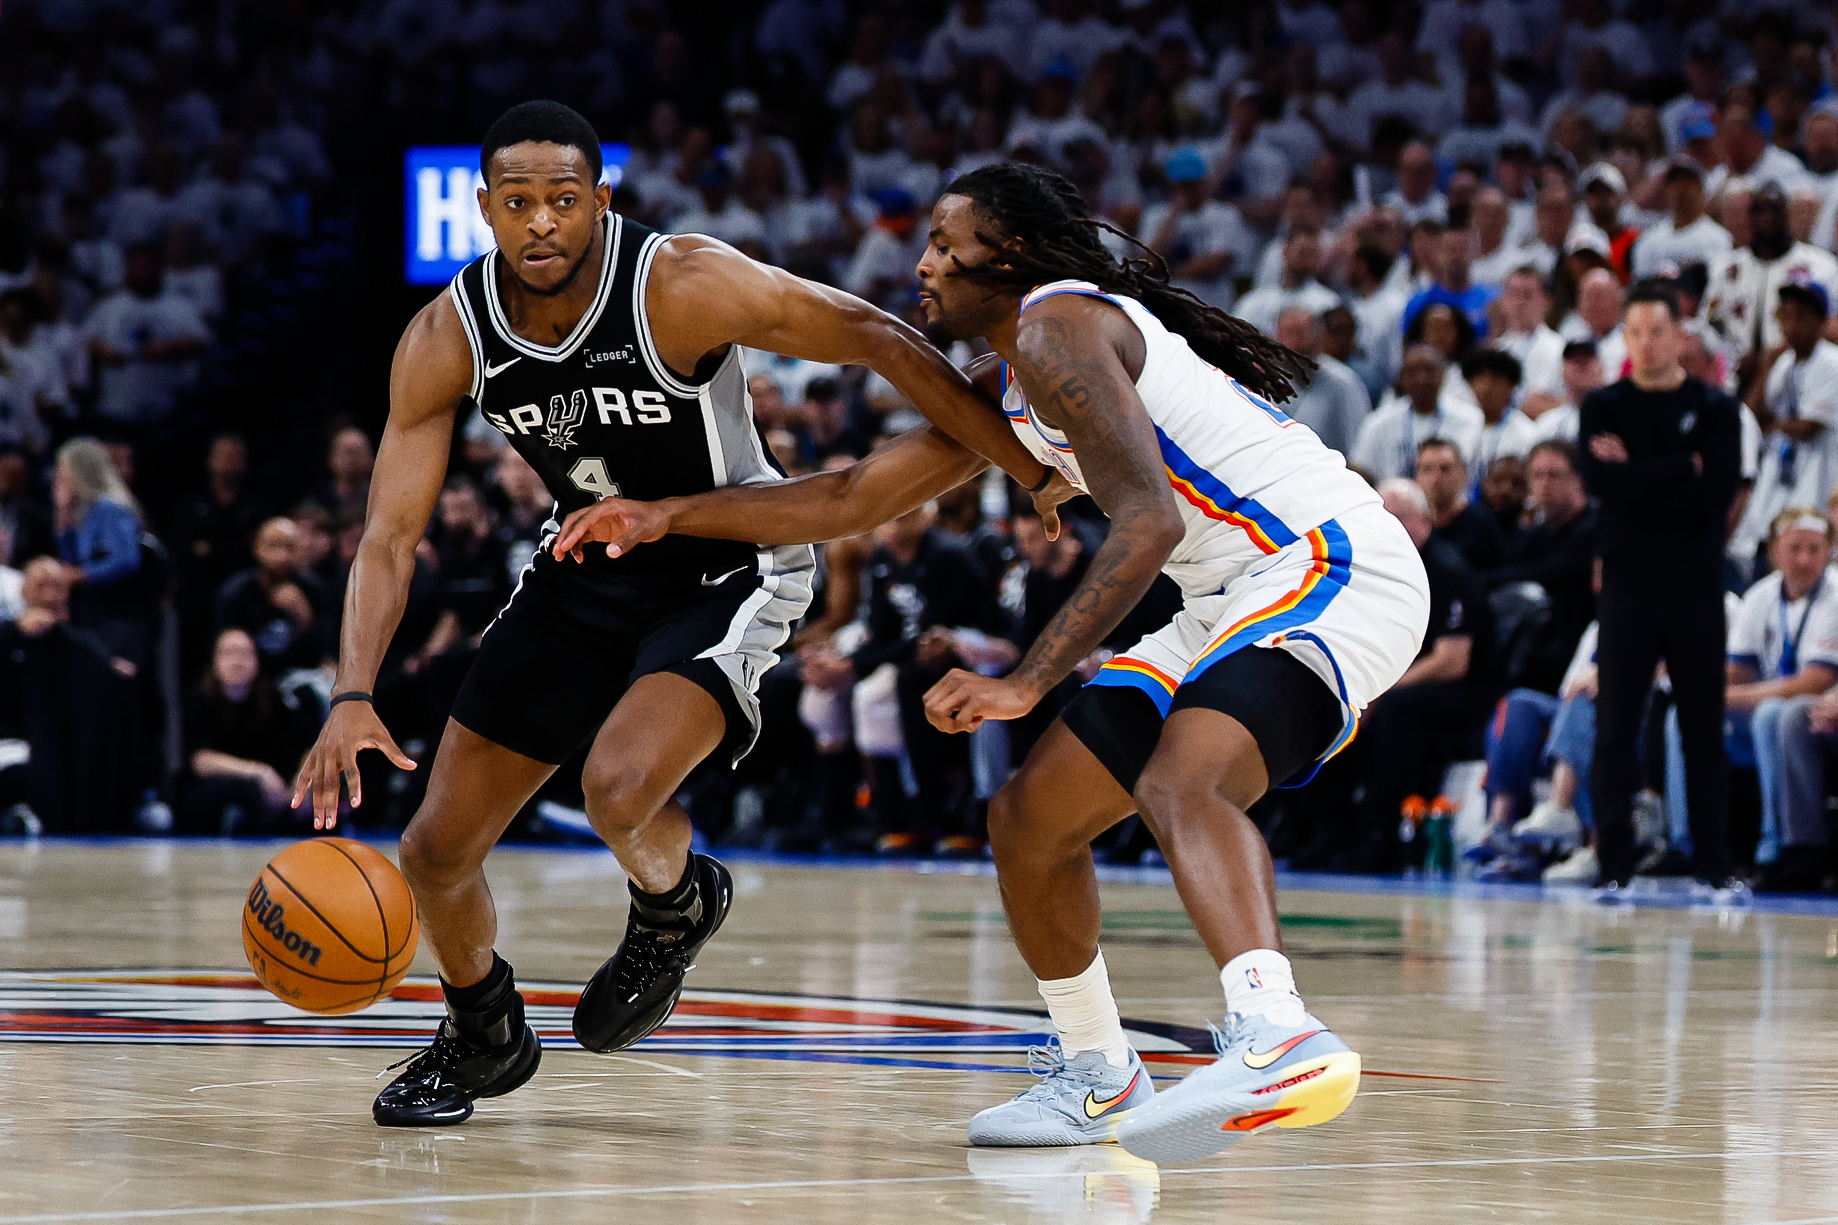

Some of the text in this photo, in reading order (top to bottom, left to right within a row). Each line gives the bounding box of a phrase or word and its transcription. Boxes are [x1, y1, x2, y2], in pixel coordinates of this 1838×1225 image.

[589, 350, 629, 363] LEDGER
[484, 386, 672, 450] SPURS
[566, 456, 624, 502] 4
[248, 875, 323, 967] Wilson
